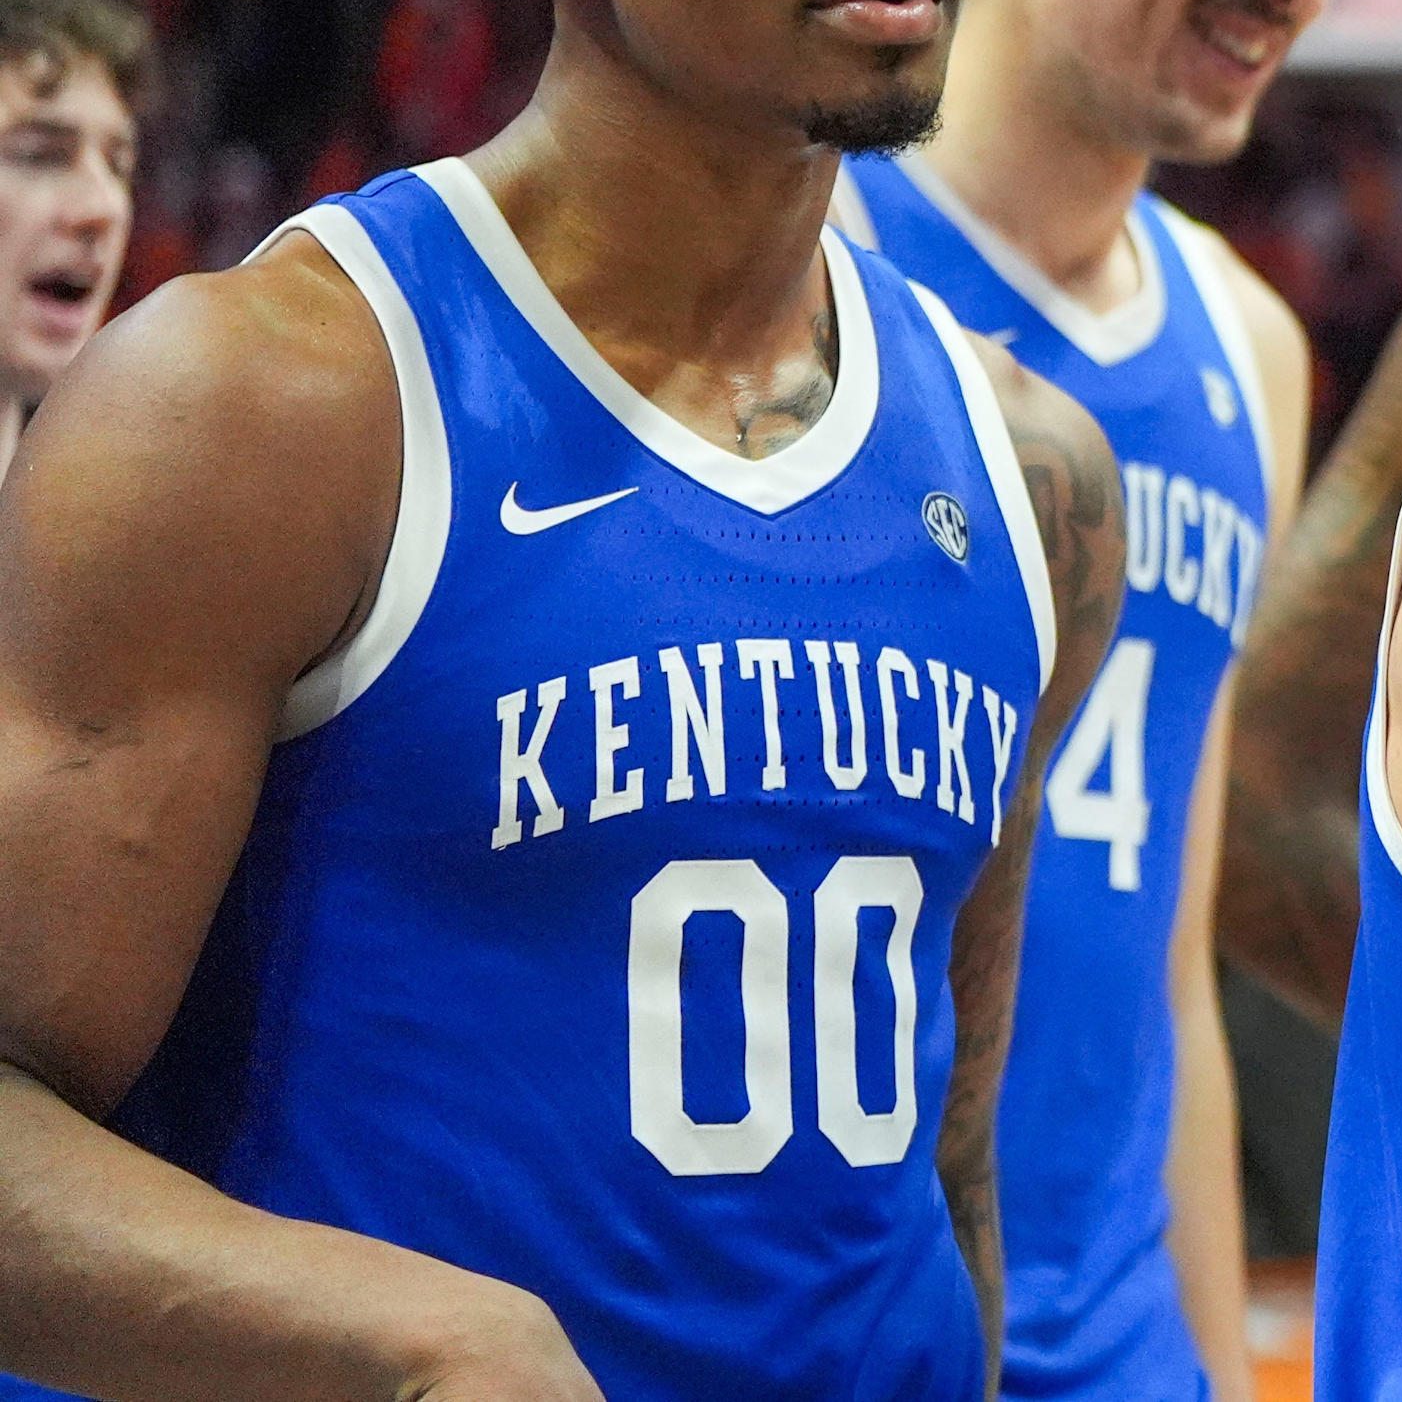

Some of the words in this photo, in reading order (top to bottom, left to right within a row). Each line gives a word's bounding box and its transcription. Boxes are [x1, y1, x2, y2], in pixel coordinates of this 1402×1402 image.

[925, 496, 967, 560] SEC
[491, 638, 1018, 850] KENTUCKY
[1045, 636, 1156, 893] 4
[627, 855, 924, 1177] 00
